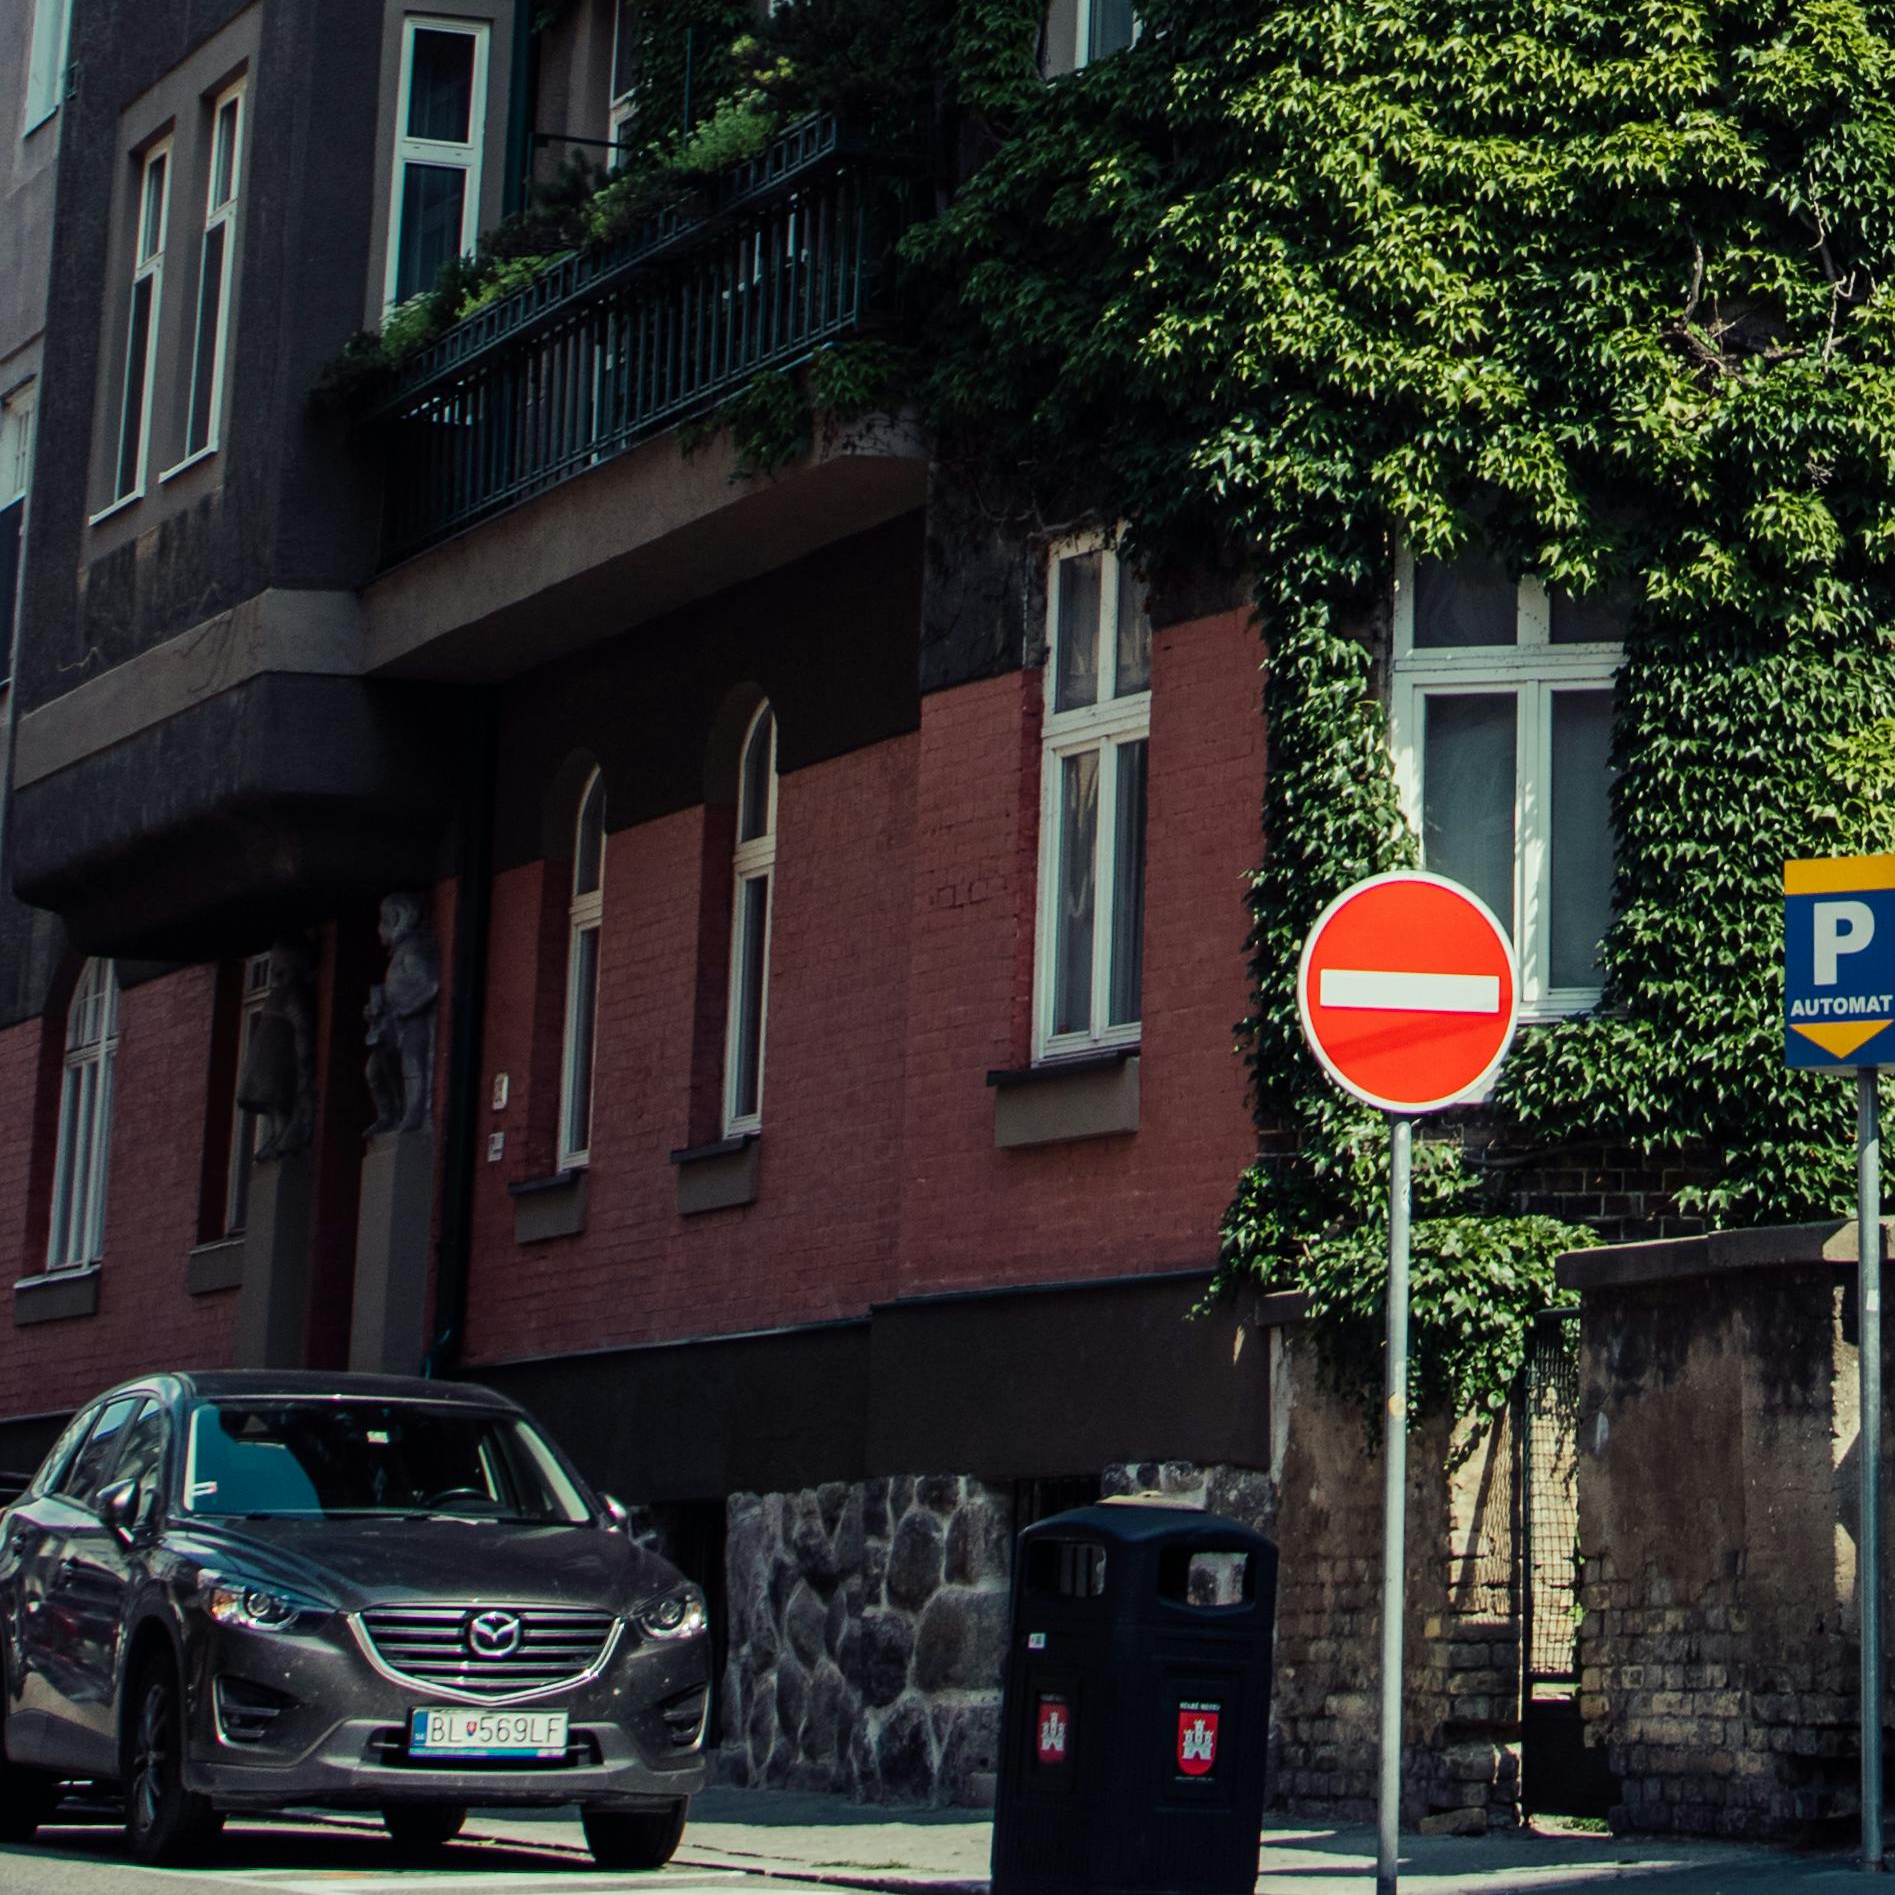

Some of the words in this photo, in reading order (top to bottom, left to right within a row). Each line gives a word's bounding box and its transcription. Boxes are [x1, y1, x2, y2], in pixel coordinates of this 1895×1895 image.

[1813, 901, 1875, 986] P
[1790, 994, 1894, 1017] AUTOMAT
[431, 1716, 462, 1743] BL
[479, 1716, 563, 1743] 569LF
